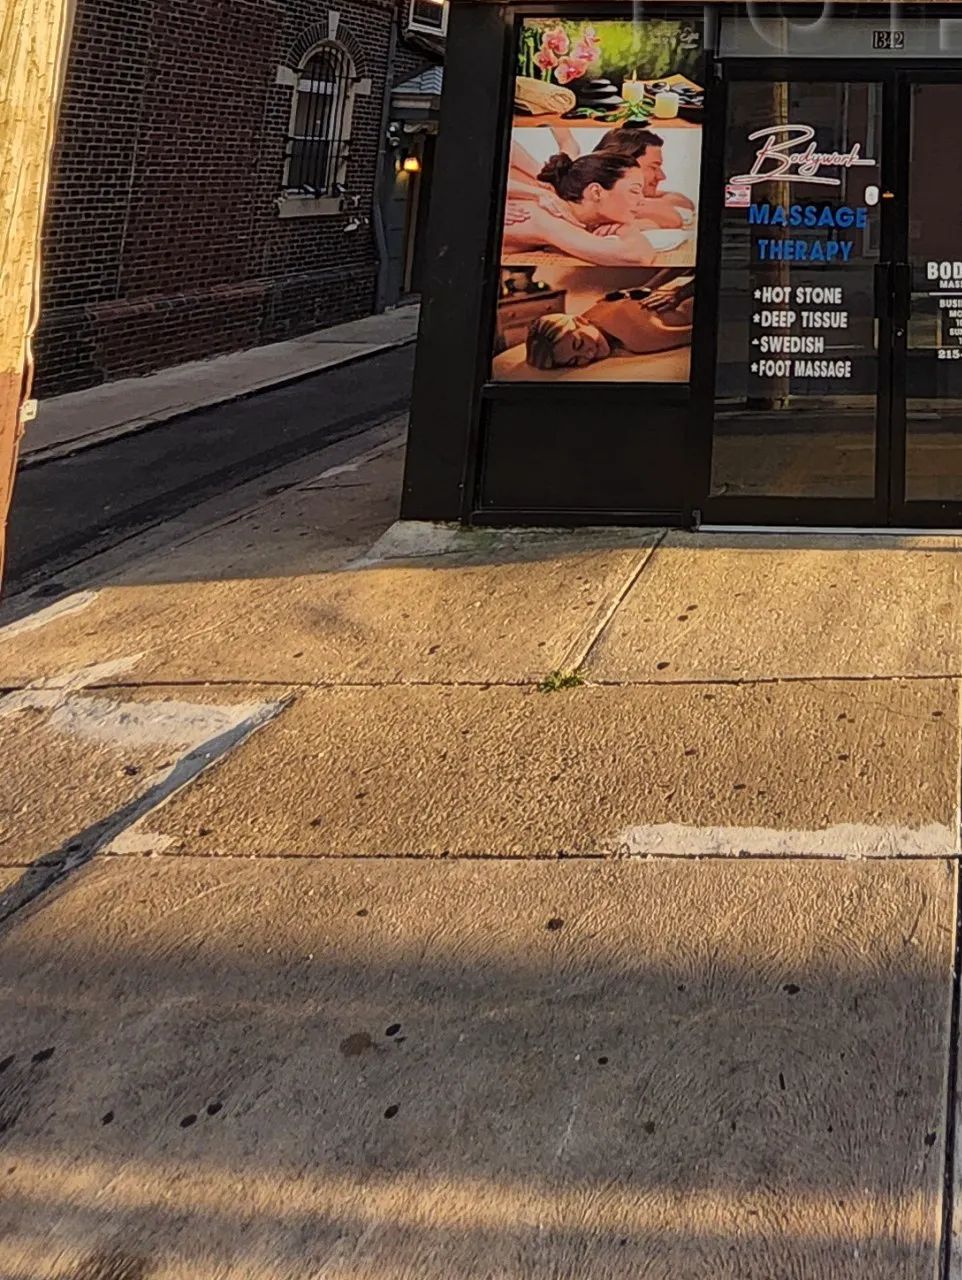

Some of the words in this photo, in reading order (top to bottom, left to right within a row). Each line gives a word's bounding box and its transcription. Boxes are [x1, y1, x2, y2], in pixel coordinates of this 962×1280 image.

[873, 30, 904, 49] 1342
[729, 124, 876, 186] Bodywork
[749, 204, 868, 228] MASSAGE
[758, 240, 853, 261] THERAPY
[796, 287, 842, 304] STONE
[801, 311, 848, 328] TISSUE
[794, 361, 852, 378] MASSAGE
